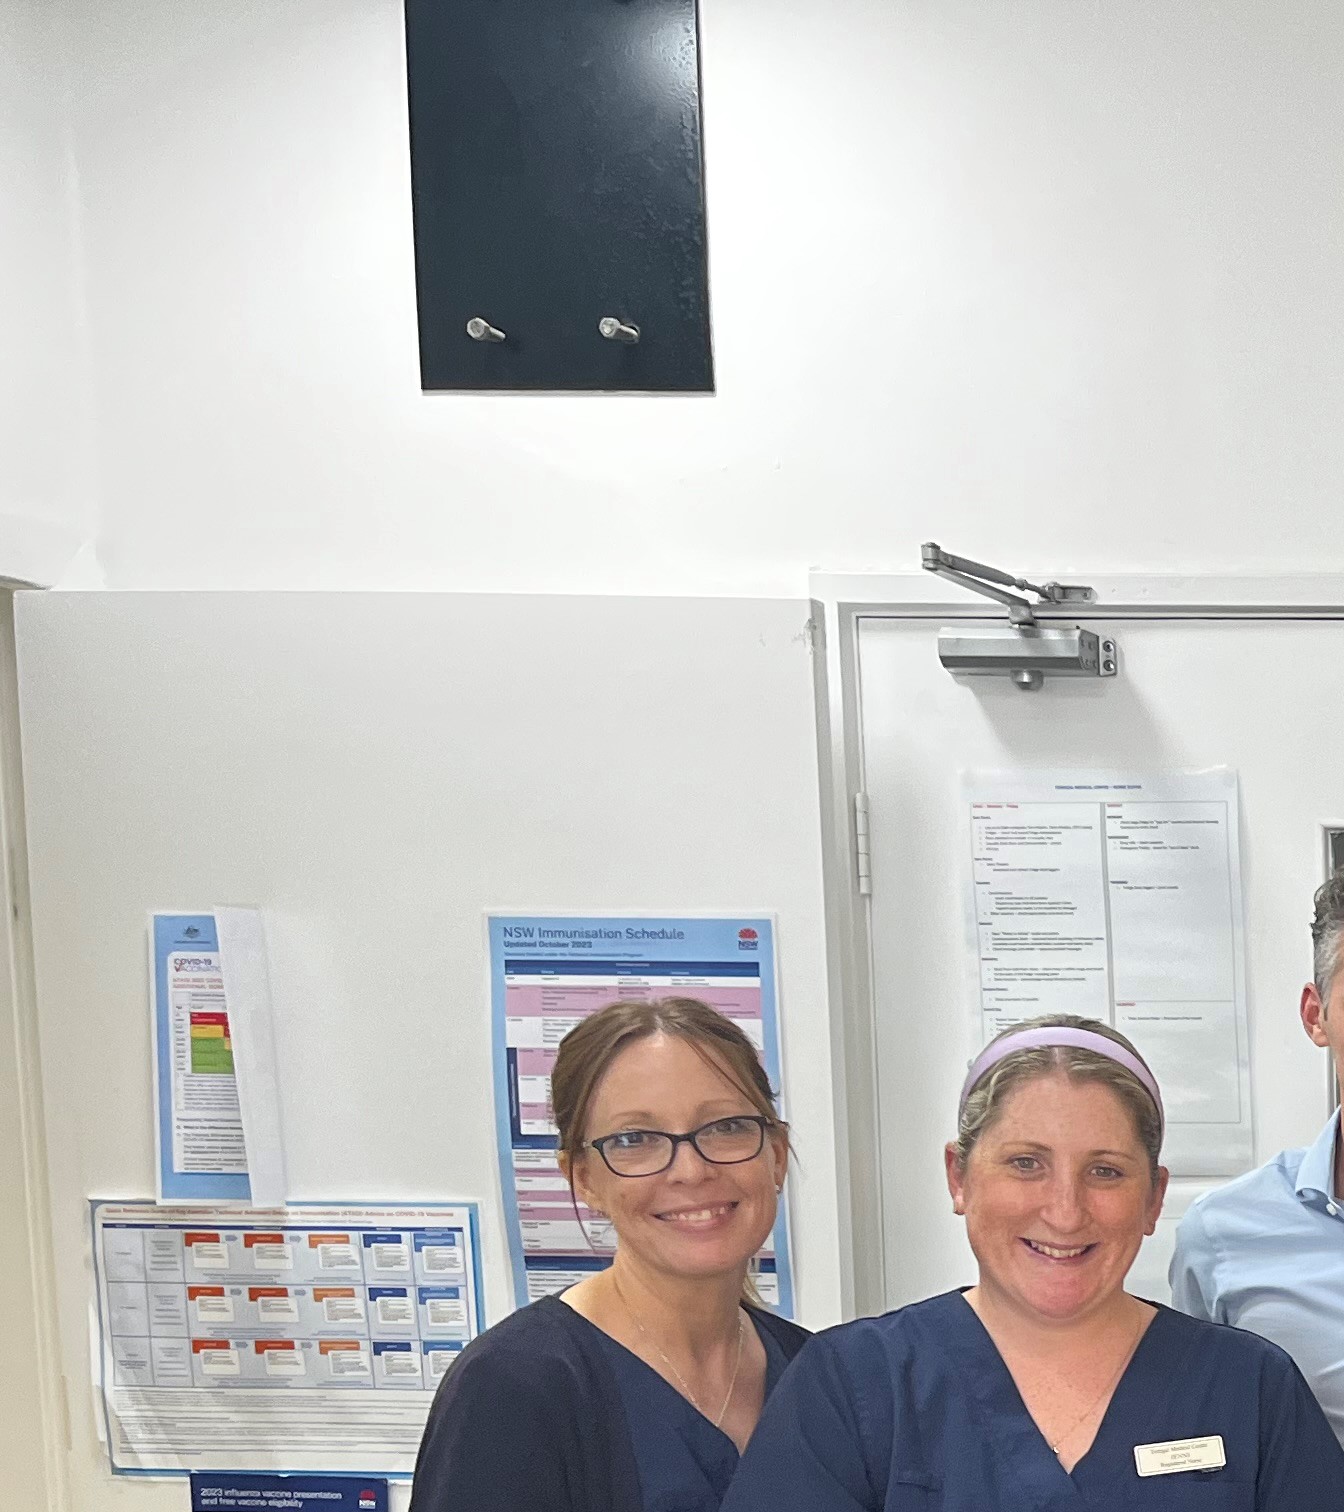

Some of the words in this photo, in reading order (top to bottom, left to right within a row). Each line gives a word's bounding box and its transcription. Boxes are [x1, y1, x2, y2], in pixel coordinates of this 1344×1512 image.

[503, 927, 535, 938] NSW
[538, 927, 623, 939] Immunisation
[625, 928, 685, 939] Schedule
[201, 1488, 223, 1497] 2023
[224, 1488, 260, 1497] influenza
[261, 1490, 292, 1498] vaccine
[293, 1491, 343, 1500] presentation
[201, 1497, 218, 1505] and
[218, 1497, 236, 1506] free
